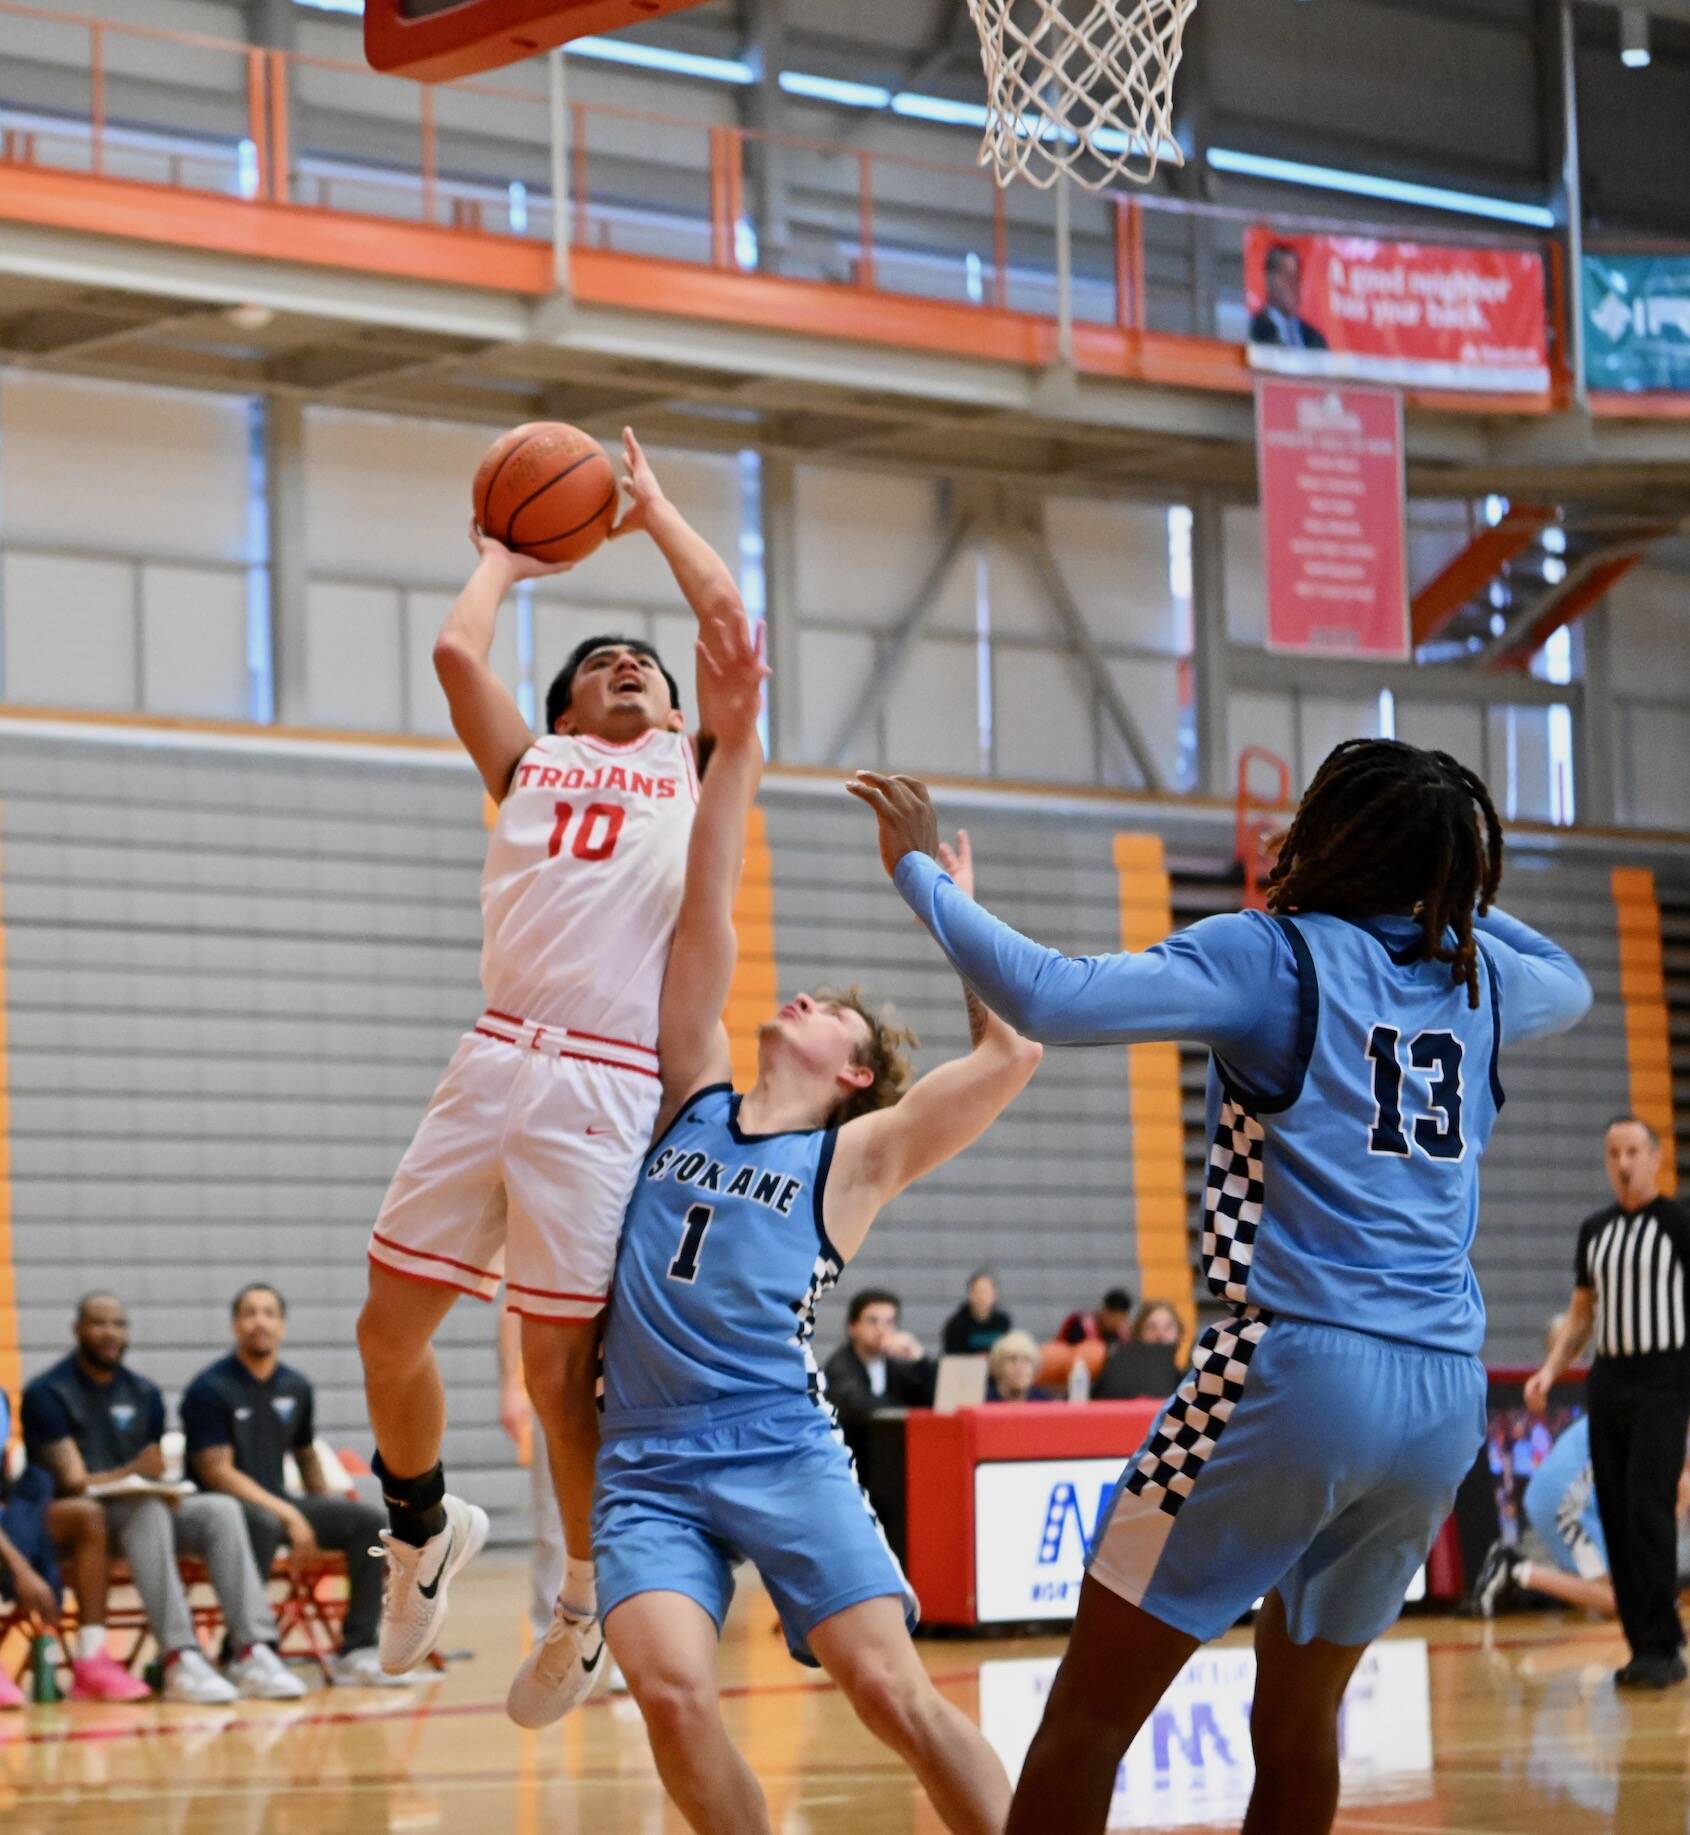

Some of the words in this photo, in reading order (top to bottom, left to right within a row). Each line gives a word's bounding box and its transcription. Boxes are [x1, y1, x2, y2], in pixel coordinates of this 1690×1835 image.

[1350, 265, 1404, 297] good
[1408, 270, 1510, 305] neighbor
[1371, 300, 1419, 328] your
[519, 764, 678, 799] TROJANS
[548, 801, 626, 862] 10
[1364, 1022, 1467, 1163] 13
[666, 1202, 715, 1286] 1
